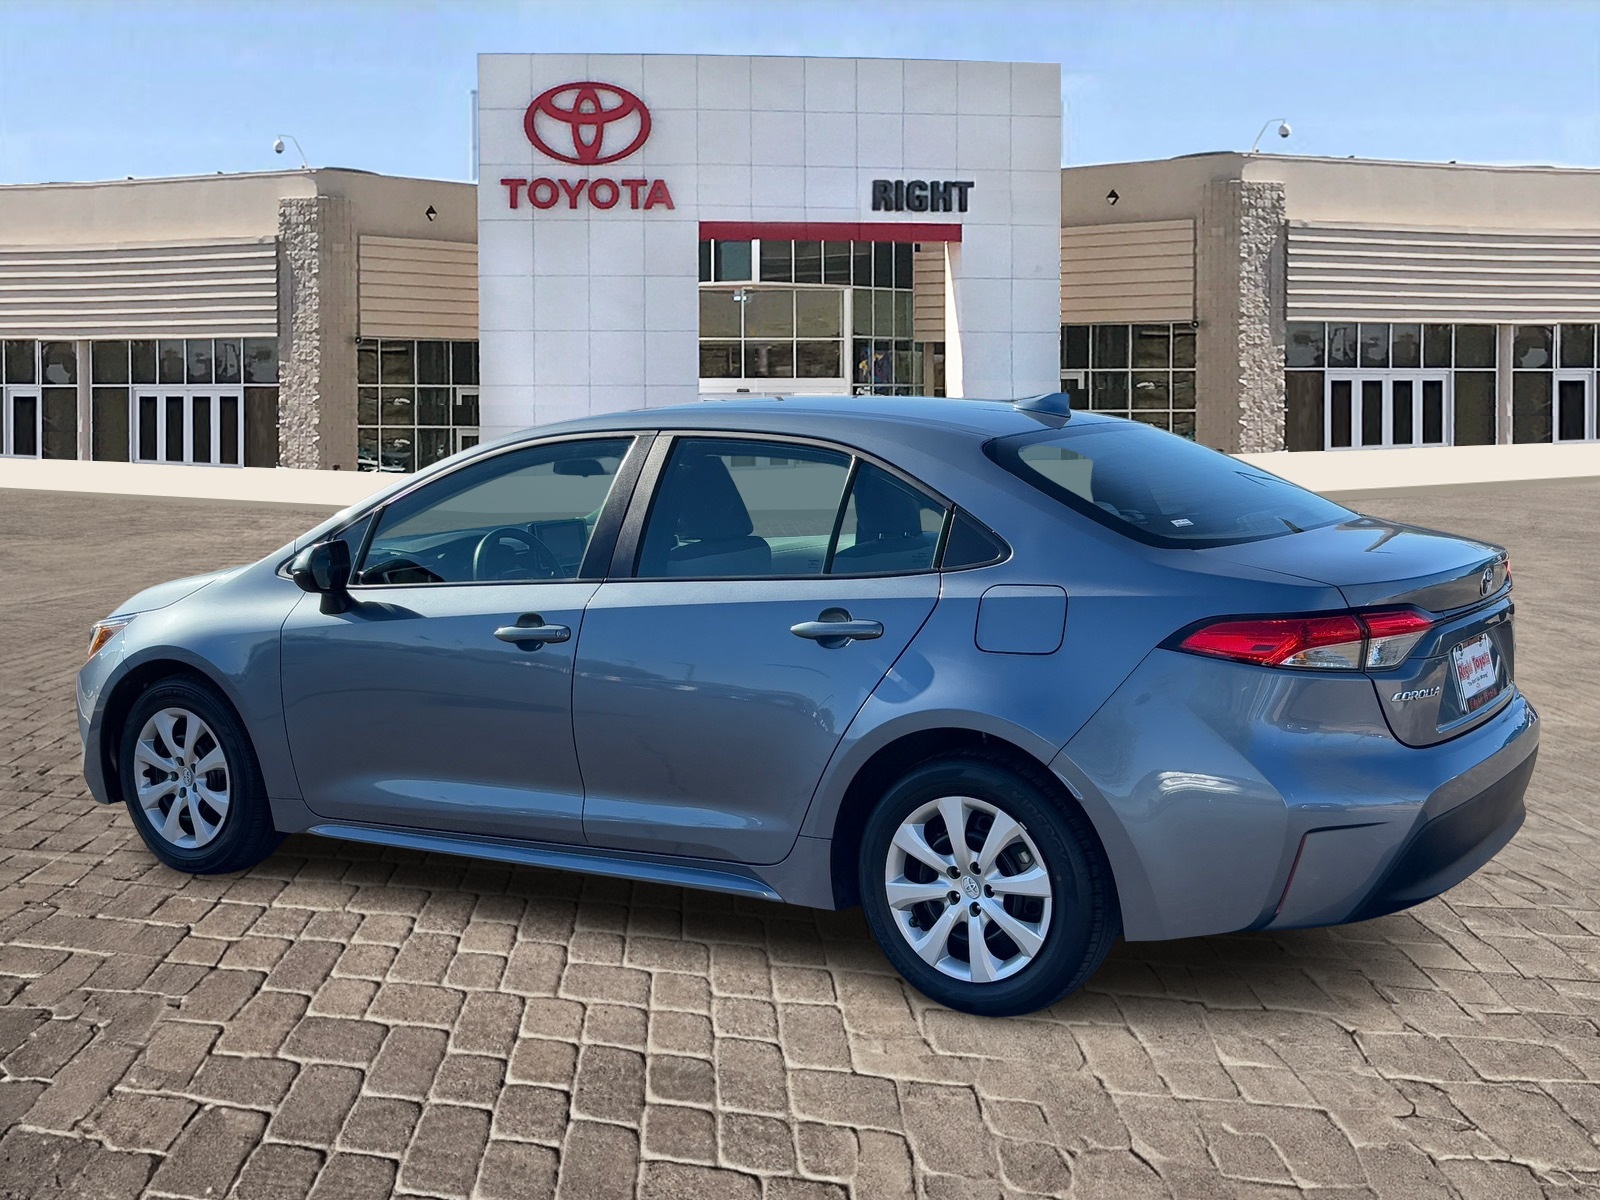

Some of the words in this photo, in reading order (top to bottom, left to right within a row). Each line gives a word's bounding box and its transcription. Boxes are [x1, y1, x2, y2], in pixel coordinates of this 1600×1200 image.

[500, 177, 675, 210] TOYOTA
[872, 179, 975, 212] RIGHT
[1391, 686, 1440, 702] COROLLA
